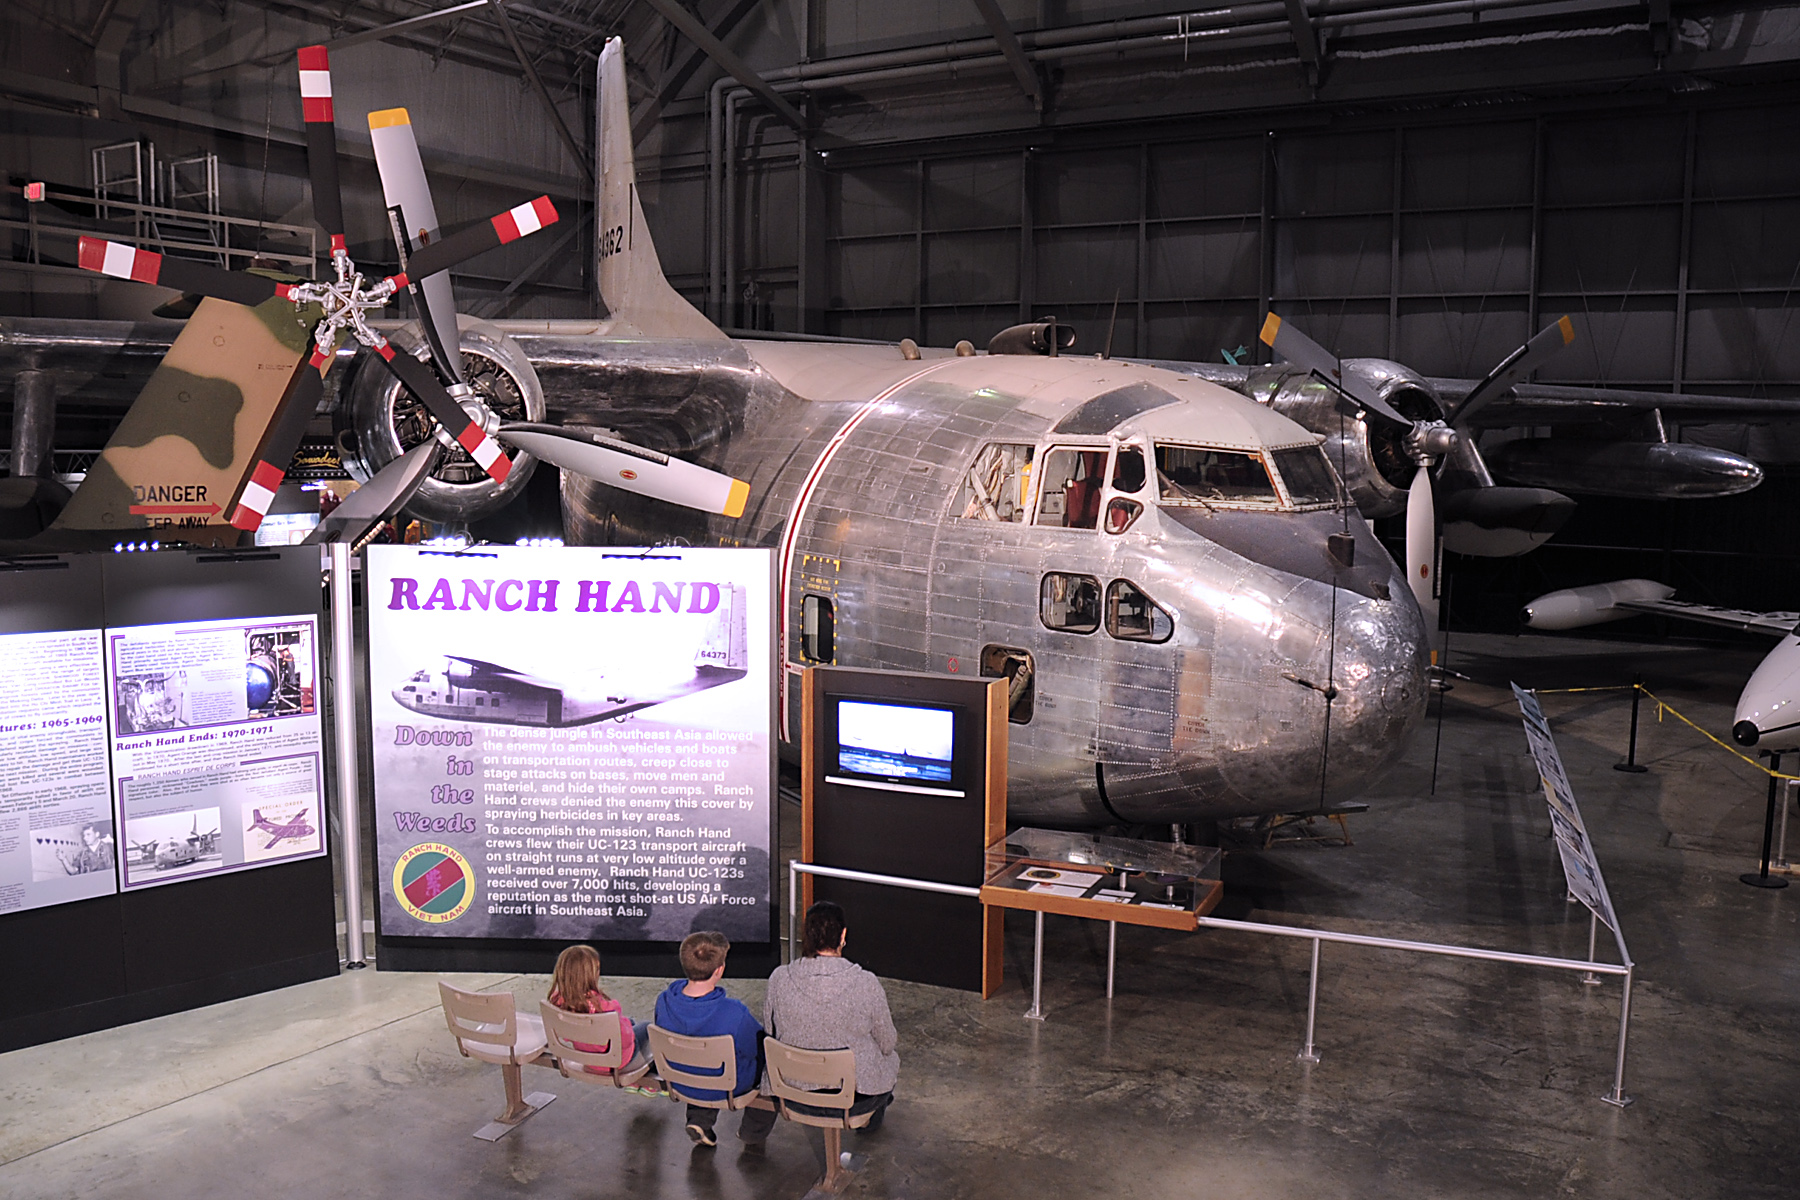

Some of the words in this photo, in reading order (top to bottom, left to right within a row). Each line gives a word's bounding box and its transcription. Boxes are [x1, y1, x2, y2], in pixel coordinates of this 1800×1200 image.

[134, 486, 207, 502] DANGER
[178, 516, 209, 530] AWAY
[388, 578, 560, 612] RANCH
[575, 580, 720, 614] HAND
[701, 650, 727, 659] 64373
[42, 715, 103, 728] 1965-1969
[116, 742, 152, 751] Ranch
[156, 736, 184, 746] Hand
[189, 732, 217, 742] Ends:
[222, 726, 273, 739] 1970-1971
[394, 725, 473, 746] Down
[482, 728, 505, 738] The
[510, 728, 546, 738] dense
[550, 728, 587, 741] jungle
[592, 728, 602, 738] in
[606, 728, 670, 740] Southeast
[674, 729, 701, 740] Asia
[705, 729, 753, 740] allowed
[483, 740, 502, 750] the
[507, 743, 547, 753] enemy
[552, 743, 564, 752] to
[568, 742, 617, 752] ambush
[622, 742, 671, 753] vehicles
[676, 743, 698, 754] and
[702, 743, 737, 754] boats
[447, 756, 474, 776] in
[483, 756, 498, 764] on
[503, 755, 590, 767] transportation
[594, 758, 636, 767] routes,
[642, 759, 676, 769] creep
[680, 757, 712, 767] close
[716, 759, 728, 768] to
[138, 772, 161, 780] RANCH
[183, 766, 204, 774] ESPRIT
[484, 769, 517, 780] stage
[522, 768, 566, 779] attacks
[590, 769, 628, 780] bases,
[634, 772, 666, 780] move
[702, 771, 724, 781] and
[431, 784, 474, 804] the
[484, 782, 537, 792] materiel,
[542, 782, 564, 792] and
[568, 782, 594, 793] hide
[598, 783, 626, 793] their
[661, 786, 704, 796] camps.
[715, 784, 753, 795] Ranch
[485, 794, 516, 805] Hand
[521, 798, 557, 806] crews
[561, 796, 602, 806] denied
[606, 797, 625, 806] the
[630, 800, 670, 809] enemy
[675, 798, 697, 808] this
[702, 800, 735, 808] cover
[740, 798, 753, 810] by
[485, 808, 536, 821] spraying
[541, 809, 603, 820] herbicides
[608, 810, 618, 820] in
[622, 810, 642, 822] key
[394, 812, 476, 834] Weeds
[486, 824, 499, 834] To
[503, 826, 572, 837] accomplish
[576, 826, 596, 836] the
[600, 826, 650, 838] mission,
[656, 827, 694, 837] Ranch
[699, 828, 730, 838] Hand
[486, 840, 522, 848] crews
[526, 838, 552, 848] flew
[556, 839, 584, 849] their
[588, 839, 636, 850] UC-123
[641, 842, 697, 852] transport
[702, 841, 746, 851] aircraft
[402, 844, 432, 862] RANCH
[436, 844, 462, 862] HAND
[506, 852, 552, 864] straight
[587, 854, 598, 862] at
[603, 856, 629, 865] very
[633, 853, 654, 863] low
[659, 854, 705, 864] altitude
[487, 864, 554, 875] well-armed
[558, 868, 600, 878] enemy.
[610, 866, 648, 876] Ranch
[653, 867, 684, 877] Hand
[689, 868, 744, 878] UC-123s
[488, 878, 538, 888] received
[572, 879, 608, 890] 7,000
[614, 880, 639, 890] hits,
[644, 880, 709, 893] developing
[488, 891, 550, 902] reputation
[554, 894, 567, 902] as
[572, 892, 591, 902] the
[596, 894, 626, 903] most
[630, 893, 673, 903] shot-at
[678, 894, 695, 904] US
[700, 894, 717, 904] Air
[722, 894, 755, 904] Force
[408, 905, 433, 921] VIET
[441, 905, 465, 921] NAM
[488, 904, 531, 914] aircraft
[536, 904, 546, 914] in
[550, 905, 612, 916] Southeast
[617, 906, 646, 916] Asia.
